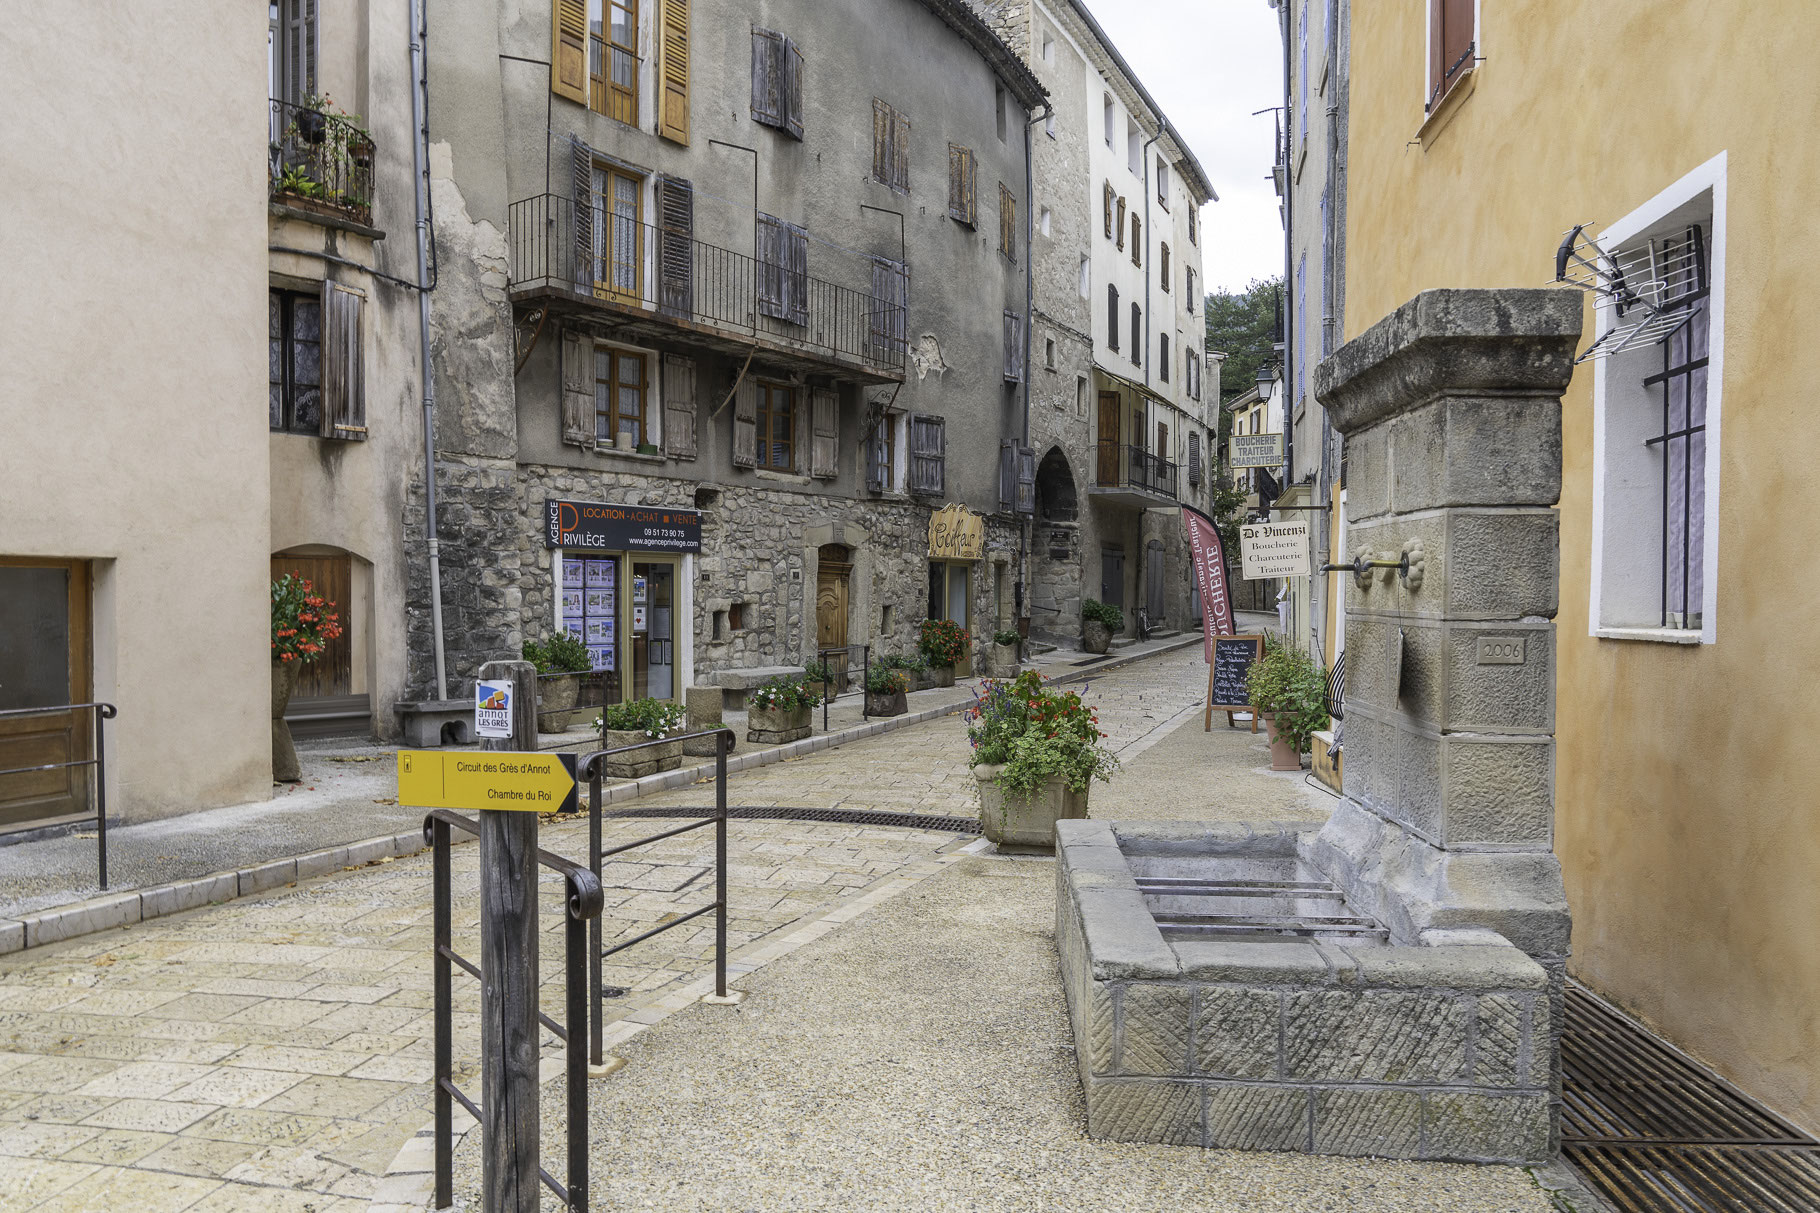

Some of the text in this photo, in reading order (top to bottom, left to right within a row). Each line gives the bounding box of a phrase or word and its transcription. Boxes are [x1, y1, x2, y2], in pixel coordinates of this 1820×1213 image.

[1236, 436, 1276, 446] BOUCHERIE
[1238, 446, 1274, 456] TRAITEUR
[1231, 456, 1282, 466] CHARCUTERIE
[583, 508, 625, 520] LOCATION
[631, 512, 658, 523] ACHAT
[673, 514, 696, 525] VENTE
[550, 502, 559, 544] AGENCE
[644, 528, 652, 536] 09
[661, 529, 668, 537] 73
[677, 530, 685, 538] 75
[1243, 524, 1306, 539] De Vincenzi
[935, 519, 976, 556] Coiffeur
[629, 538, 698, 548] www.agenceprivilege.com
[1252, 541, 1298, 550] Boucherie
[1249, 553, 1302, 563] Charcuterie
[1258, 565, 1294, 574] Traiteur
[1484, 643, 1520, 658] 2006
[492, 719, 508, 727] GRÈS
[457, 762, 551, 774] Circuit des Grès d'Annot
[487, 789, 552, 801] Chambre du Roi
